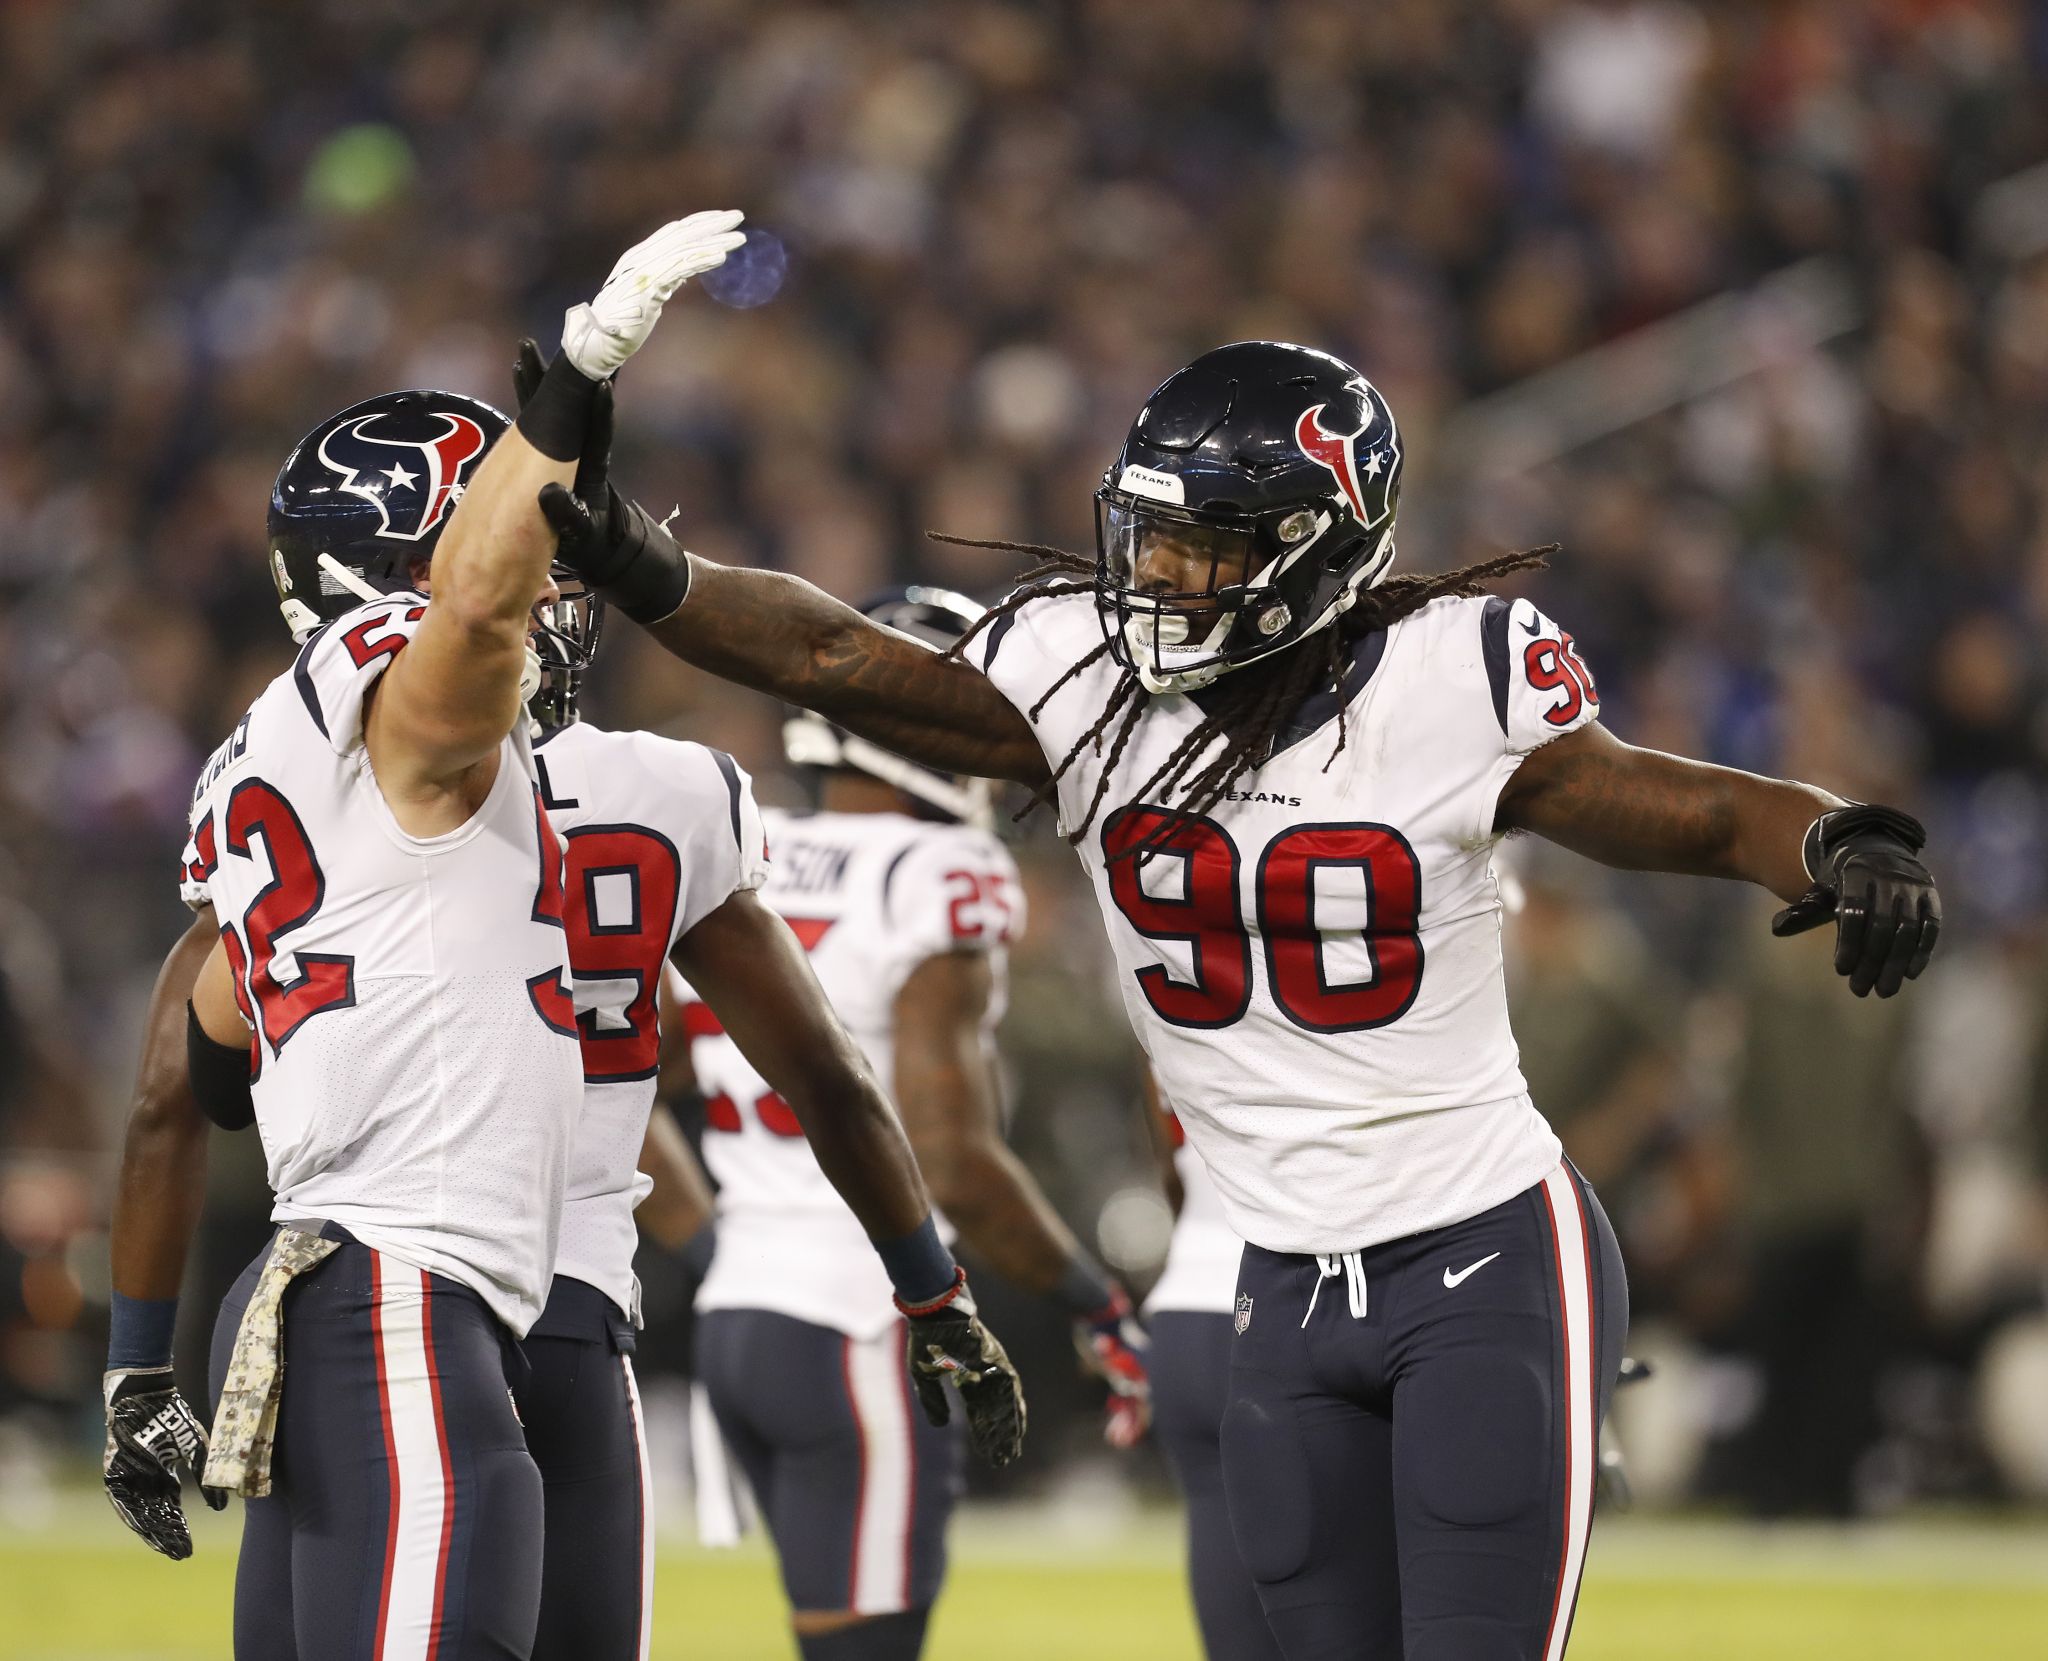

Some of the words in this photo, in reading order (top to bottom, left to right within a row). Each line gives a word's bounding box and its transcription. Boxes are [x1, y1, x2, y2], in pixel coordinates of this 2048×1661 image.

[1129, 470, 1172, 487] TEXANS
[339, 606, 429, 671] 5
[1523, 629, 1600, 726] 90
[1225, 791, 1302, 807] EXANS
[1100, 803, 1425, 1034] 90
[156, 1403, 198, 1460] RVICE
